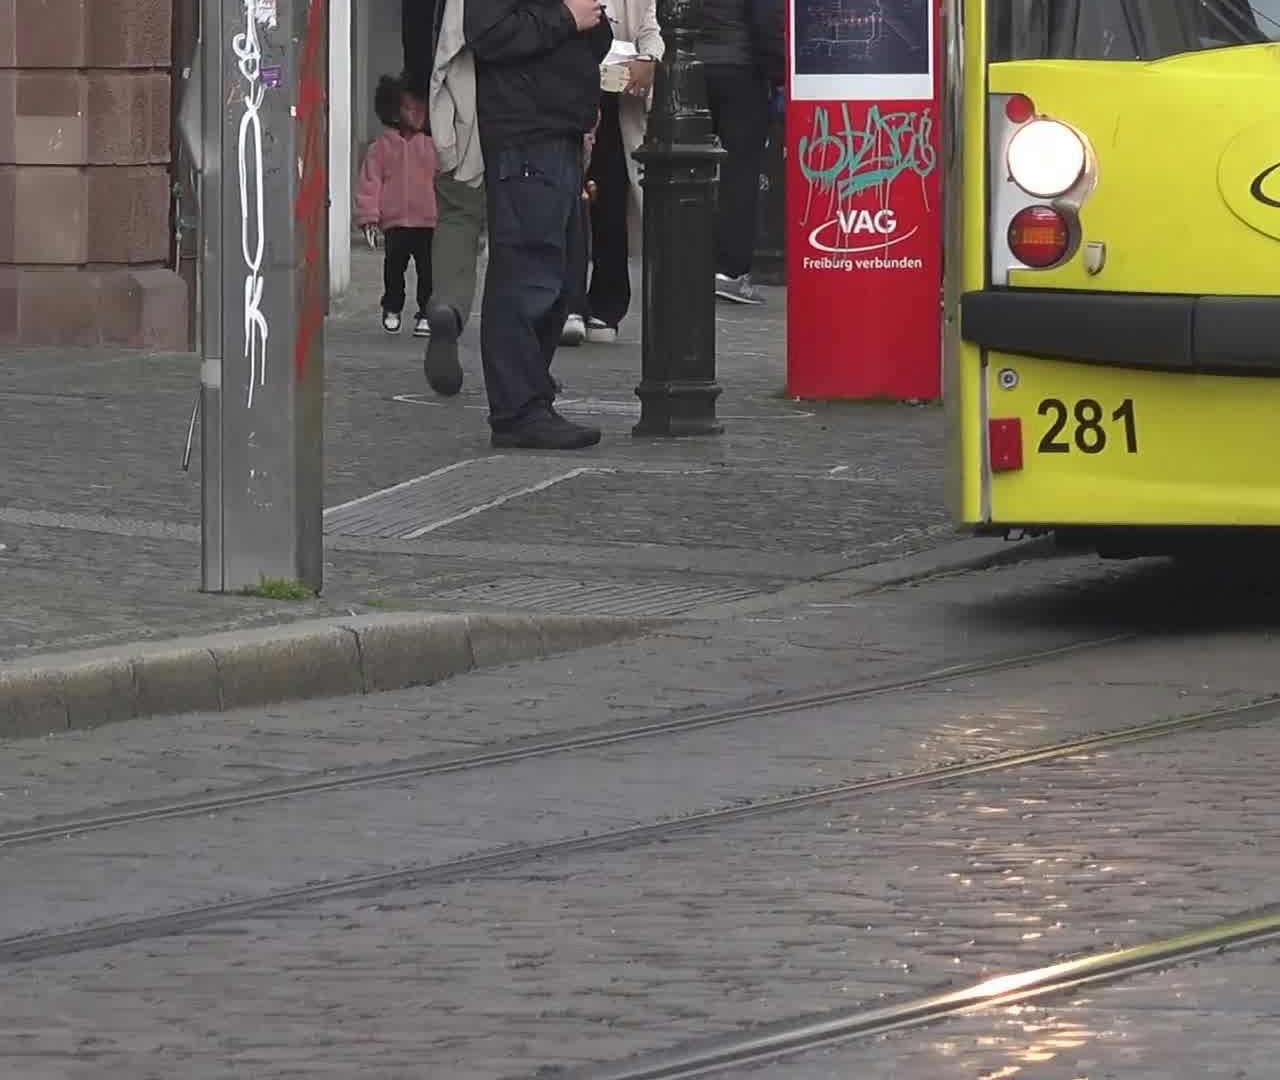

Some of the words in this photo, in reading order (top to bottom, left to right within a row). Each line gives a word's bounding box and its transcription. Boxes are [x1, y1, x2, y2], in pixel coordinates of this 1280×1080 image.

[836, 209, 898, 234] VAG
[802, 257, 854, 272] Freiburg
[855, 256, 923, 270] verbunden
[1037, 398, 1138, 454] 281
